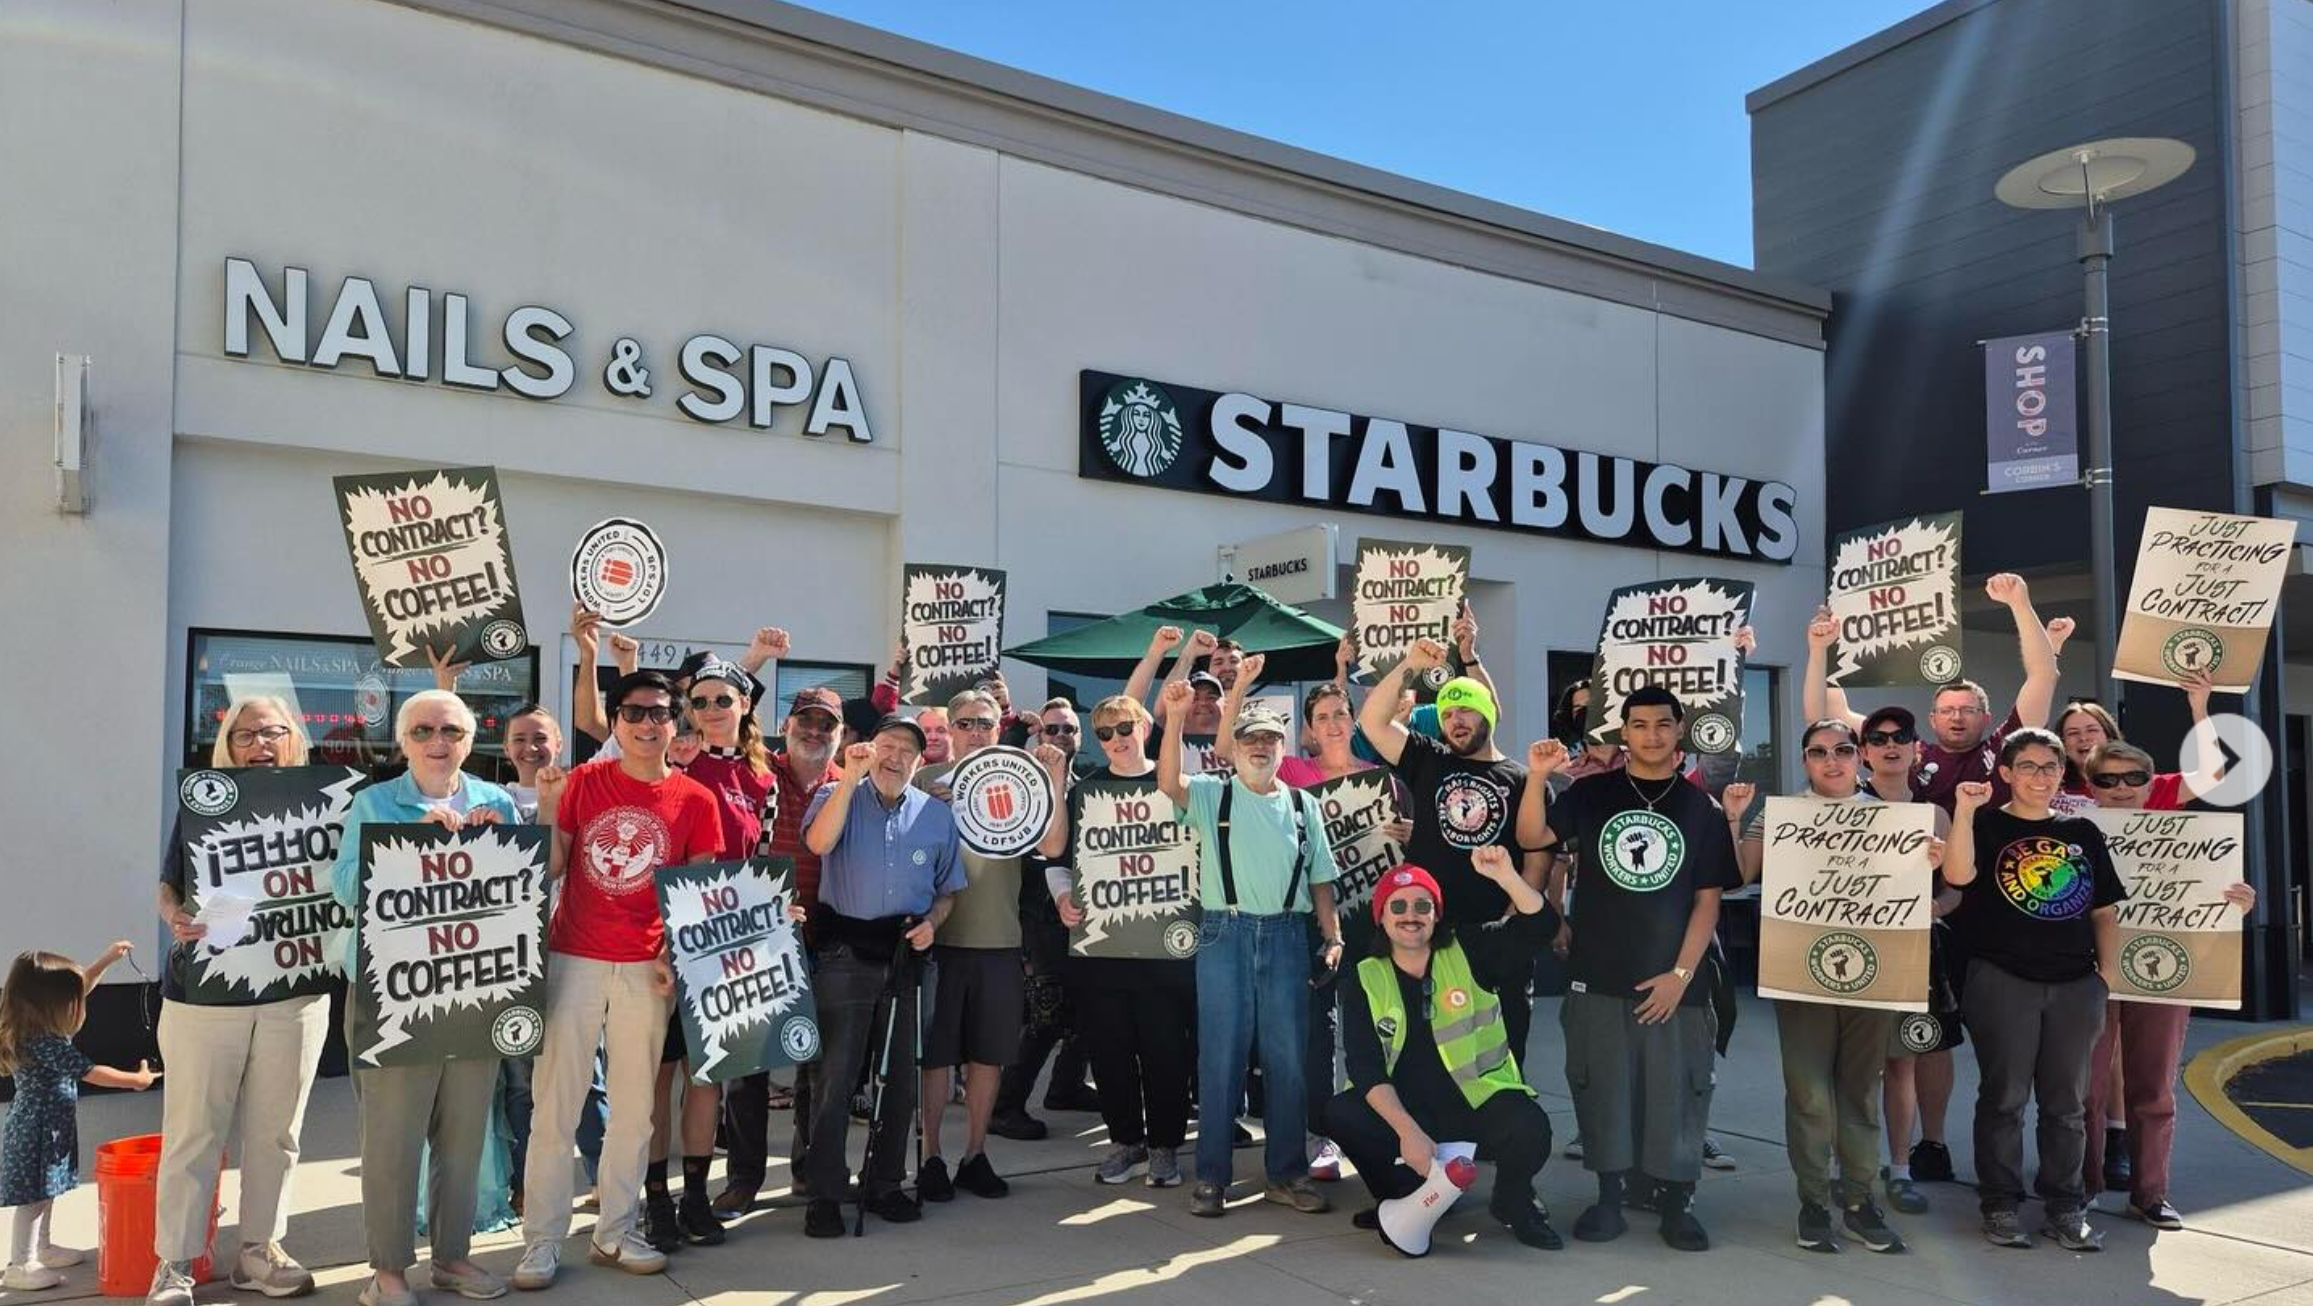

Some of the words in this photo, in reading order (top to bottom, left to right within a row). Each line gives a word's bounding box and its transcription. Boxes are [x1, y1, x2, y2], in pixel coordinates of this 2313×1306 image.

[224, 256, 576, 401] NAILS
[603, 337, 651, 399] &
[676, 334, 873, 444] SPA
[2016, 345, 2047, 437] SHOP
[1209, 392, 1799, 561] STARBUCKS
[387, 495, 432, 524] NO
[360, 505, 488, 558] CONTRACT?
[2189, 515, 2258, 540] JUST
[586, 530, 620, 556] UNITED
[1868, 538, 1903, 562] NO
[2149, 531, 2287, 565] PRACTICING
[406, 554, 452, 584] NO
[1248, 558, 1308, 582] STARBUCKS
[1390, 560, 1420, 578] NO
[1837, 544, 1946, 591] CONTRACT?
[2195, 562, 2220, 573] FOR
[2223, 564, 2233, 574] A
[384, 561, 502, 621] COFFEE!
[580, 559, 601, 608] WORKERS
[935, 582, 964, 600] NO
[1362, 575, 1456, 600] CONTRACT?
[2175, 574, 2249, 600] JUST
[911, 596, 996, 622] CONTRACT?
[1648, 595, 1688, 616] NO
[1869, 586, 1906, 611] NO
[2140, 588, 2269, 625] CONTRACT!
[1390, 605, 1420, 623] NO
[1612, 611, 1736, 640] CONTRACT?
[1842, 592, 1945, 644] COFFEE!
[938, 625, 966, 643] NO
[915, 635, 991, 668] COFFEE!
[1647, 644, 1688, 666] NO
[483, 663, 512, 681] SPA
[1613, 658, 1727, 697] COFFEE!
[956, 759, 999, 800] WORKERS
[1002, 760, 1038, 787] UNITED
[1115, 801, 1151, 823] NO
[1320, 799, 1342, 822] O
[1325, 798, 1385, 845] TRACT?
[1813, 803, 1889, 828] JUST
[2123, 813, 2198, 836] JUST
[982, 826, 1032, 845] LDFSJB
[1612, 815, 1676, 839] STARBUCKS
[1772, 822, 1928, 855] PRACTICING
[1604, 843, 1638, 885] WORKERS
[1650, 853, 1678, 884] UNITED
[1827, 856, 1853, 867] FOR
[1858, 856, 1869, 868] A
[2007, 842, 2033, 860] BE
[2036, 840, 2079, 861] GA
[420, 851, 473, 883] NO
[1119, 854, 1155, 877] NO
[2137, 862, 2166, 874] FOR
[2169, 863, 2179, 874] A
[263, 866, 315, 898] NO
[376, 868, 534, 922] CONTRACT?
[1091, 865, 1190, 909] COFFEE!
[1809, 870, 1892, 898] JUST
[2001, 872, 2026, 901] AND
[2027, 878, 2091, 915] ORGANIZE
[2125, 876, 2203, 902] JUST
[701, 886, 739, 917] NO
[1775, 887, 1920, 926] CONTRACT!
[427, 921, 480, 955] NO
[679, 895, 785, 953] CONTRACT?
[274, 936, 324, 970] NO
[1818, 934, 1870, 955] STARBUCKS
[2130, 938, 2182, 956] STARBUCKS
[386, 933, 528, 1002] COFFEE!
[719, 947, 756, 979] NO
[1851, 965, 1875, 989] UNITED
[701, 953, 796, 1022] COFFEE!
